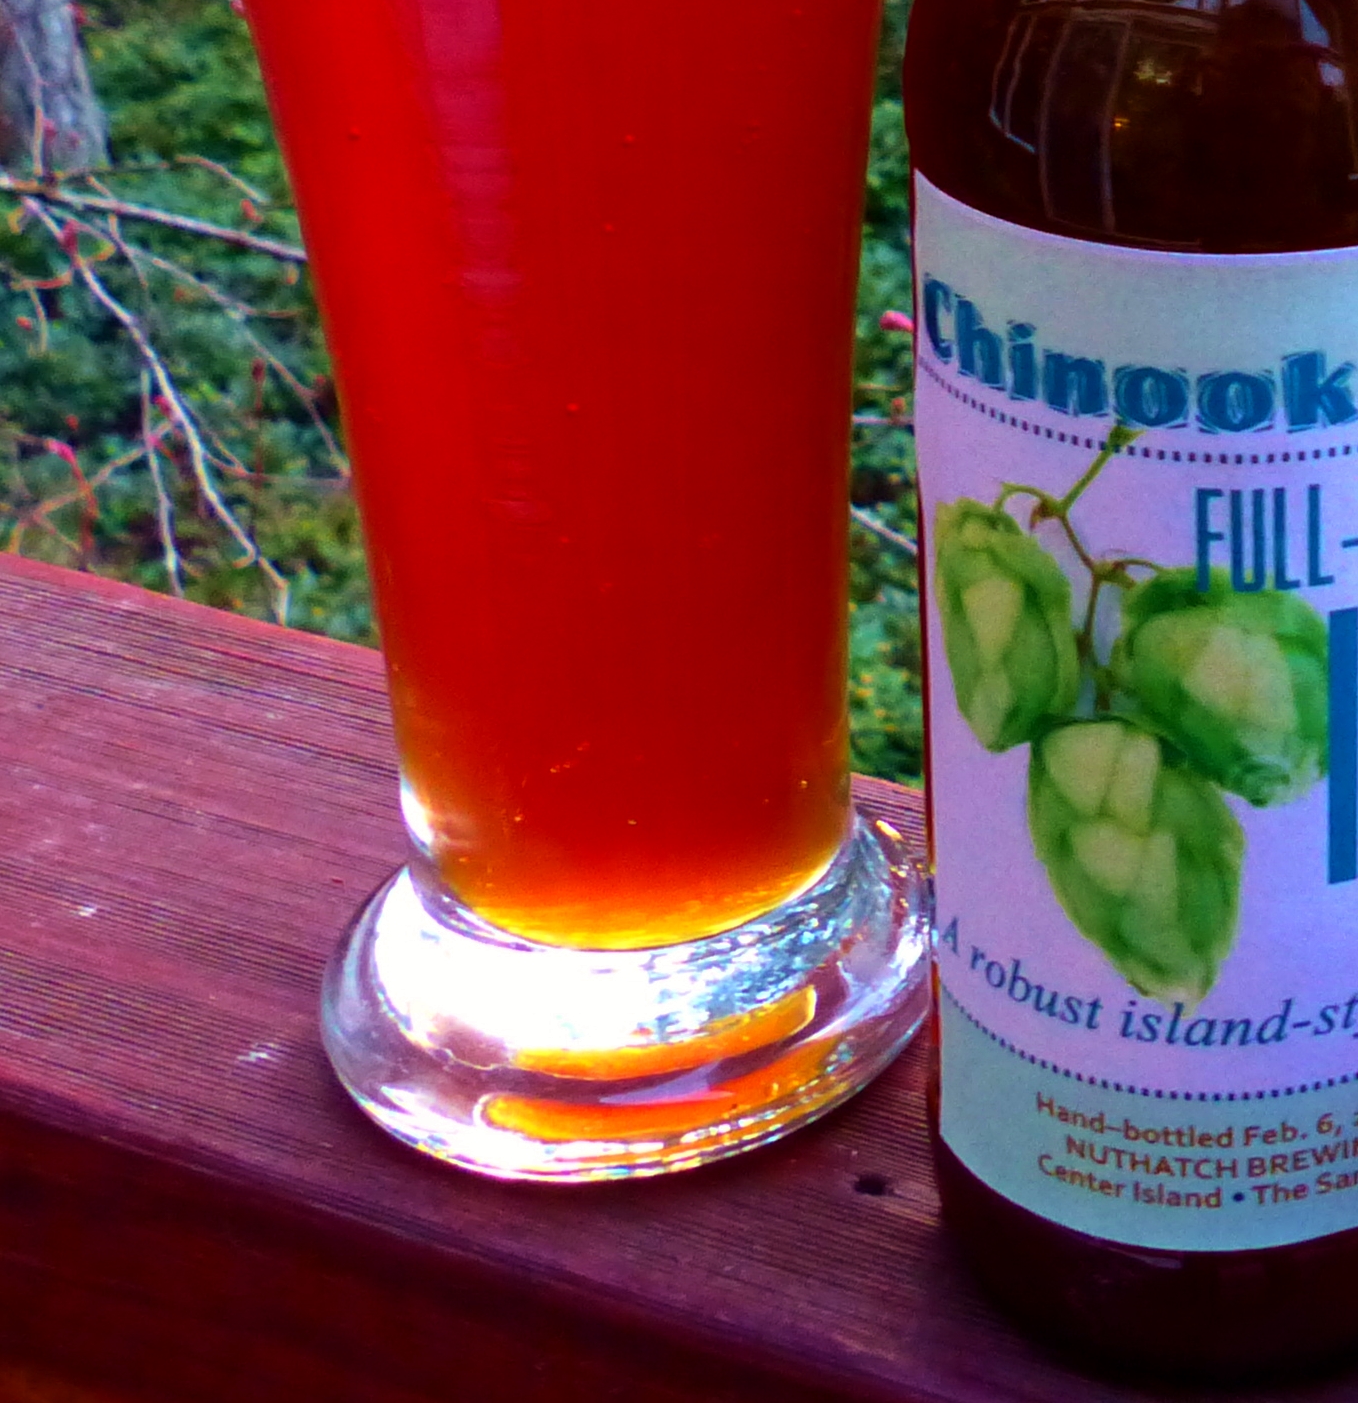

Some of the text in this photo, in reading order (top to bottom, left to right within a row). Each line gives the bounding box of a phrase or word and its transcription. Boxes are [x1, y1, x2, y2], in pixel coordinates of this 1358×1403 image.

[941, 916, 960, 955] A
[970, 943, 1104, 1031] robust
[1036, 1092, 1234, 1149] Hand-bottled
[1243, 1122, 1308, 1147] Feb.
[1316, 1112, 1343, 1138] 6,
[1038, 1155, 1126, 1198] Center
[1133, 1181, 1222, 1209] Island
[1251, 1183, 1309, 1205] The
[1066, 1134, 1239, 1179] NUTHATCH
